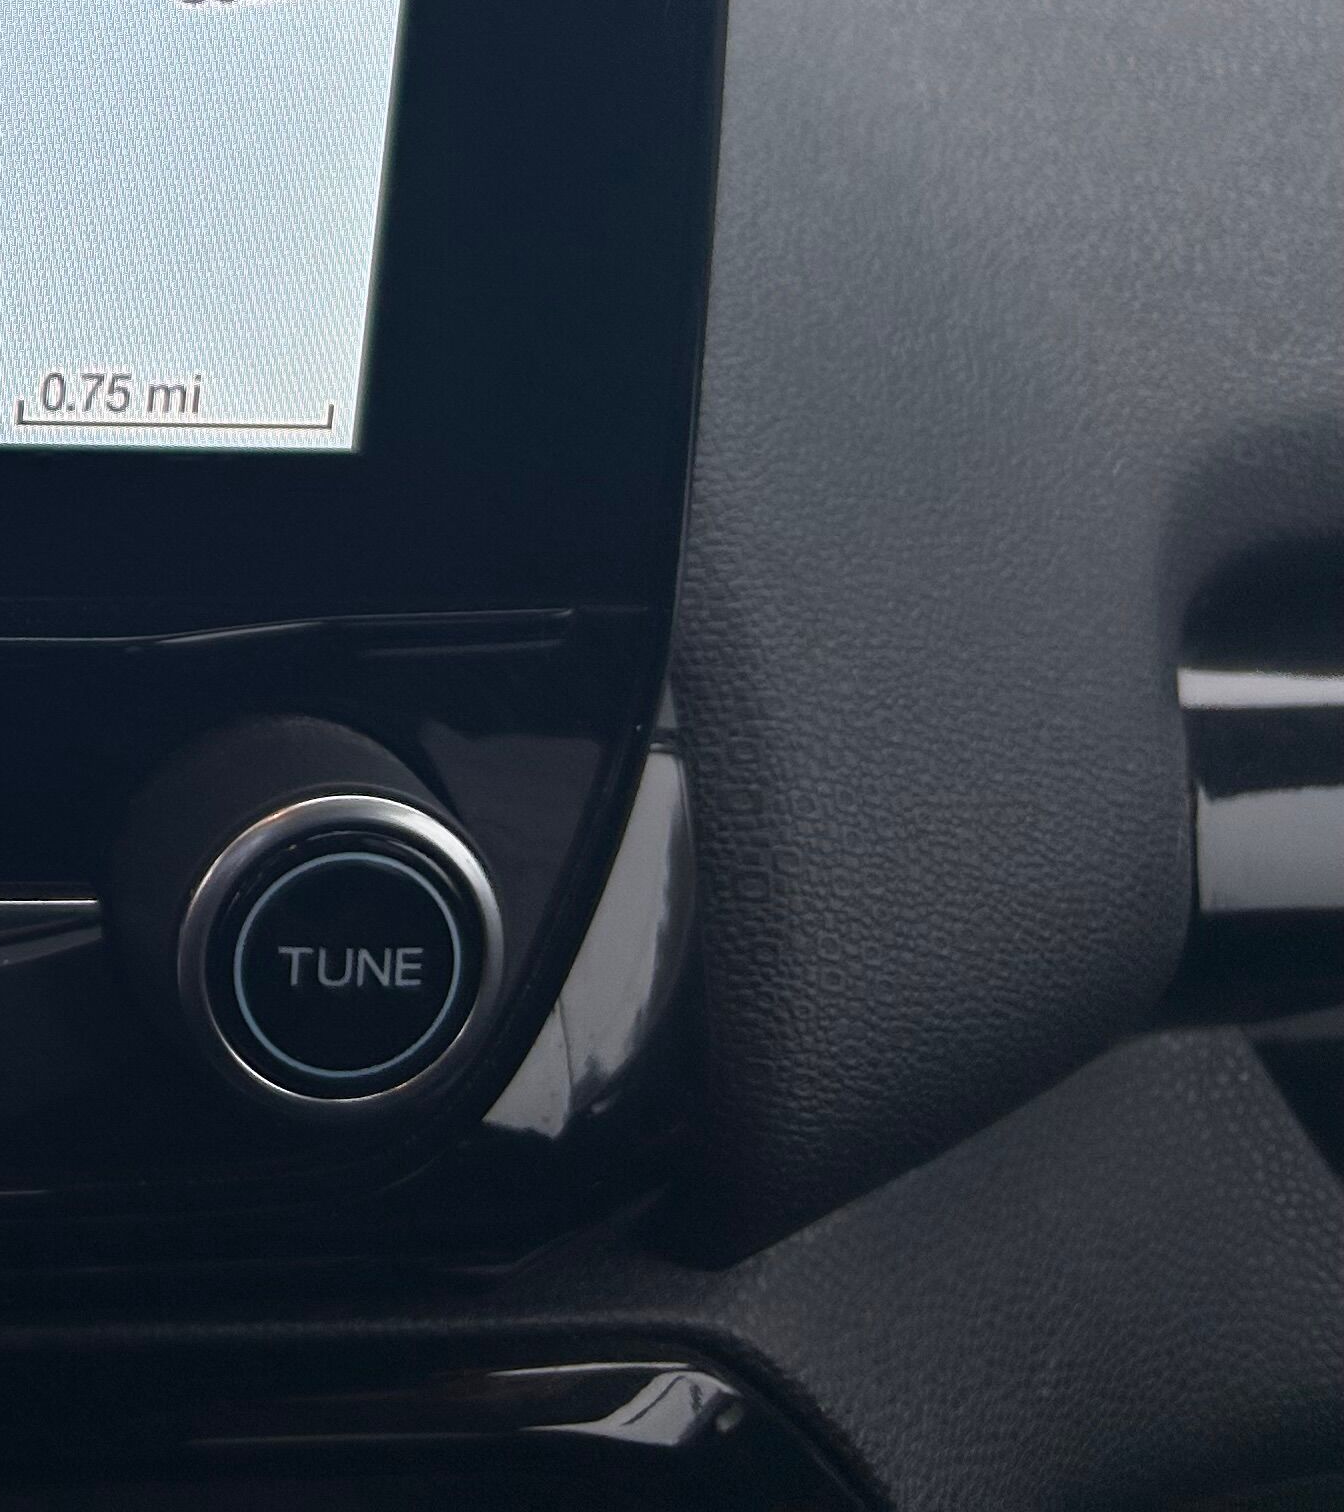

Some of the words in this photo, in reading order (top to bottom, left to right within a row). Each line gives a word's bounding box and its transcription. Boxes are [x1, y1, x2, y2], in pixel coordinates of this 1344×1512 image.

[39, 372, 132, 414] 0.75
[147, 374, 202, 415] mi
[277, 946, 424, 987] TUNE
